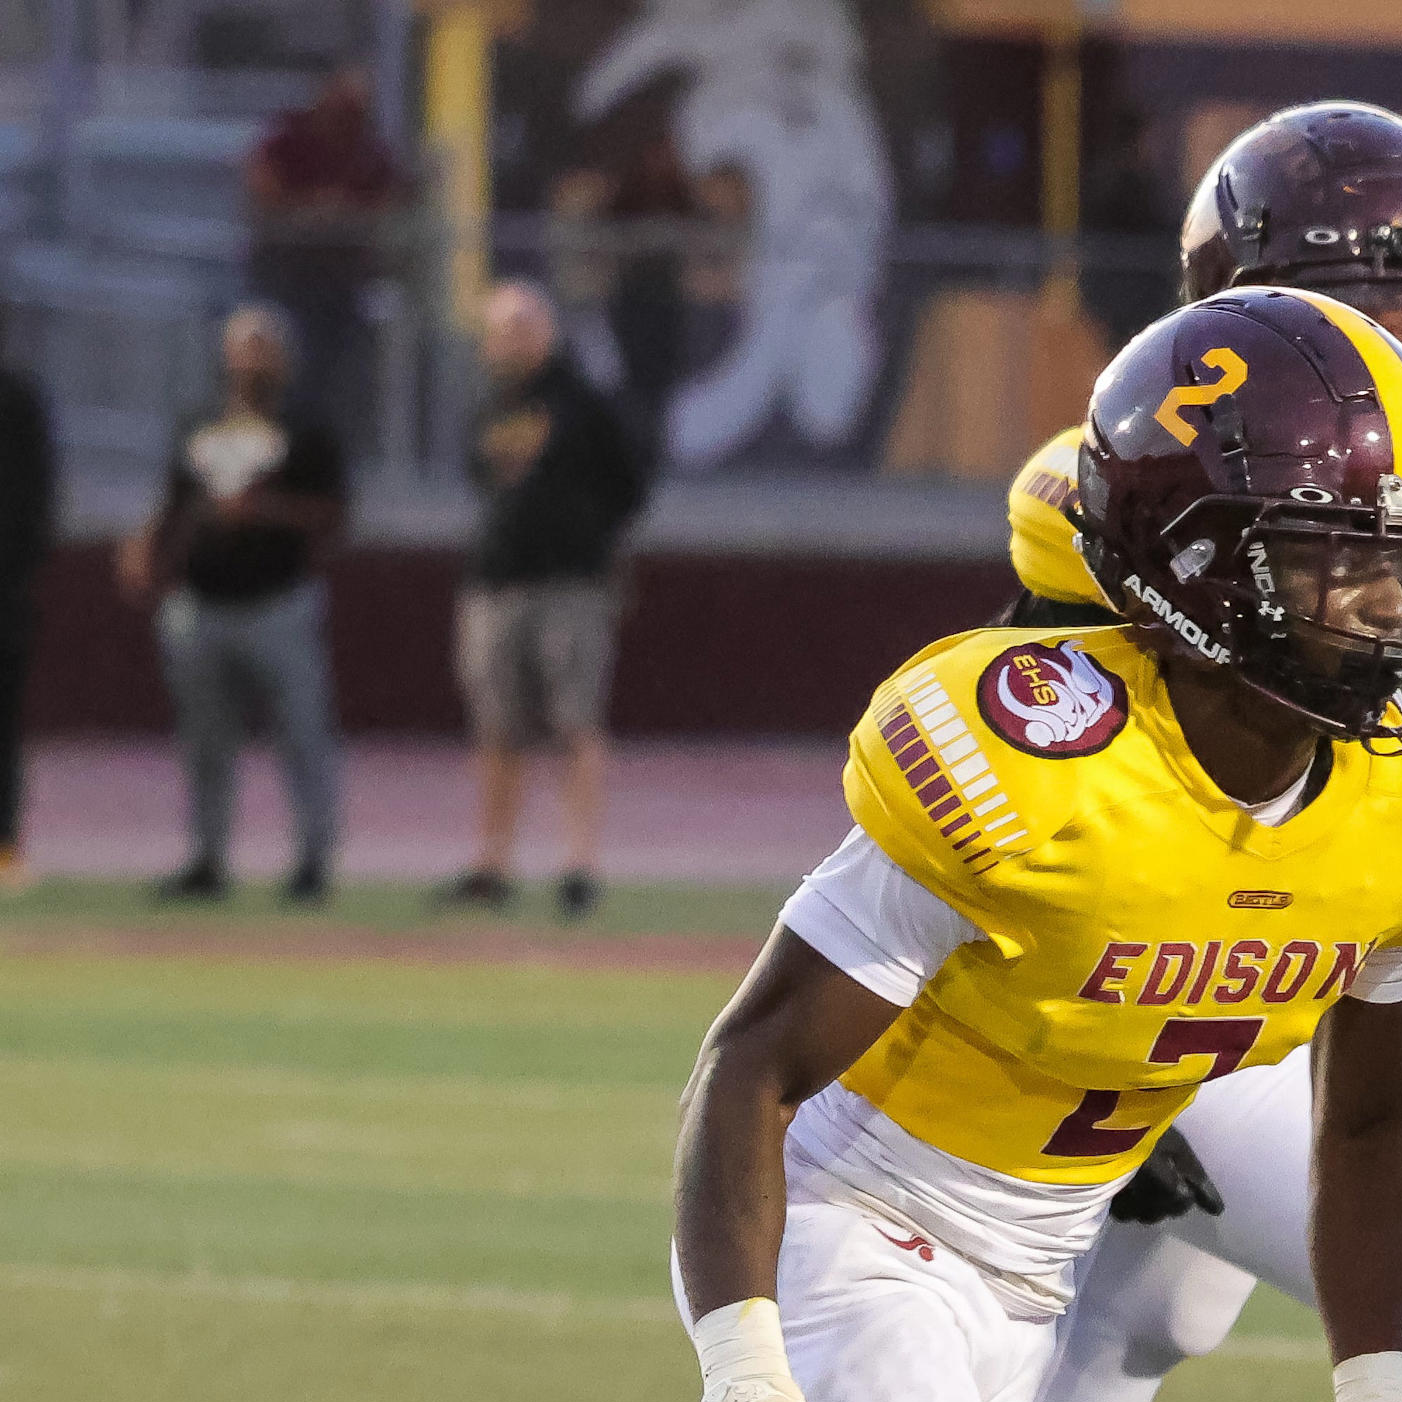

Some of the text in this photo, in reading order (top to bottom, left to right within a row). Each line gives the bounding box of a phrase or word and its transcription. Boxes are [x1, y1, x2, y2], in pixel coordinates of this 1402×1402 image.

[1154, 347, 1248, 447] 2
[1013, 654, 1057, 705] EHS
[1077, 939, 1379, 1007] EDISON
